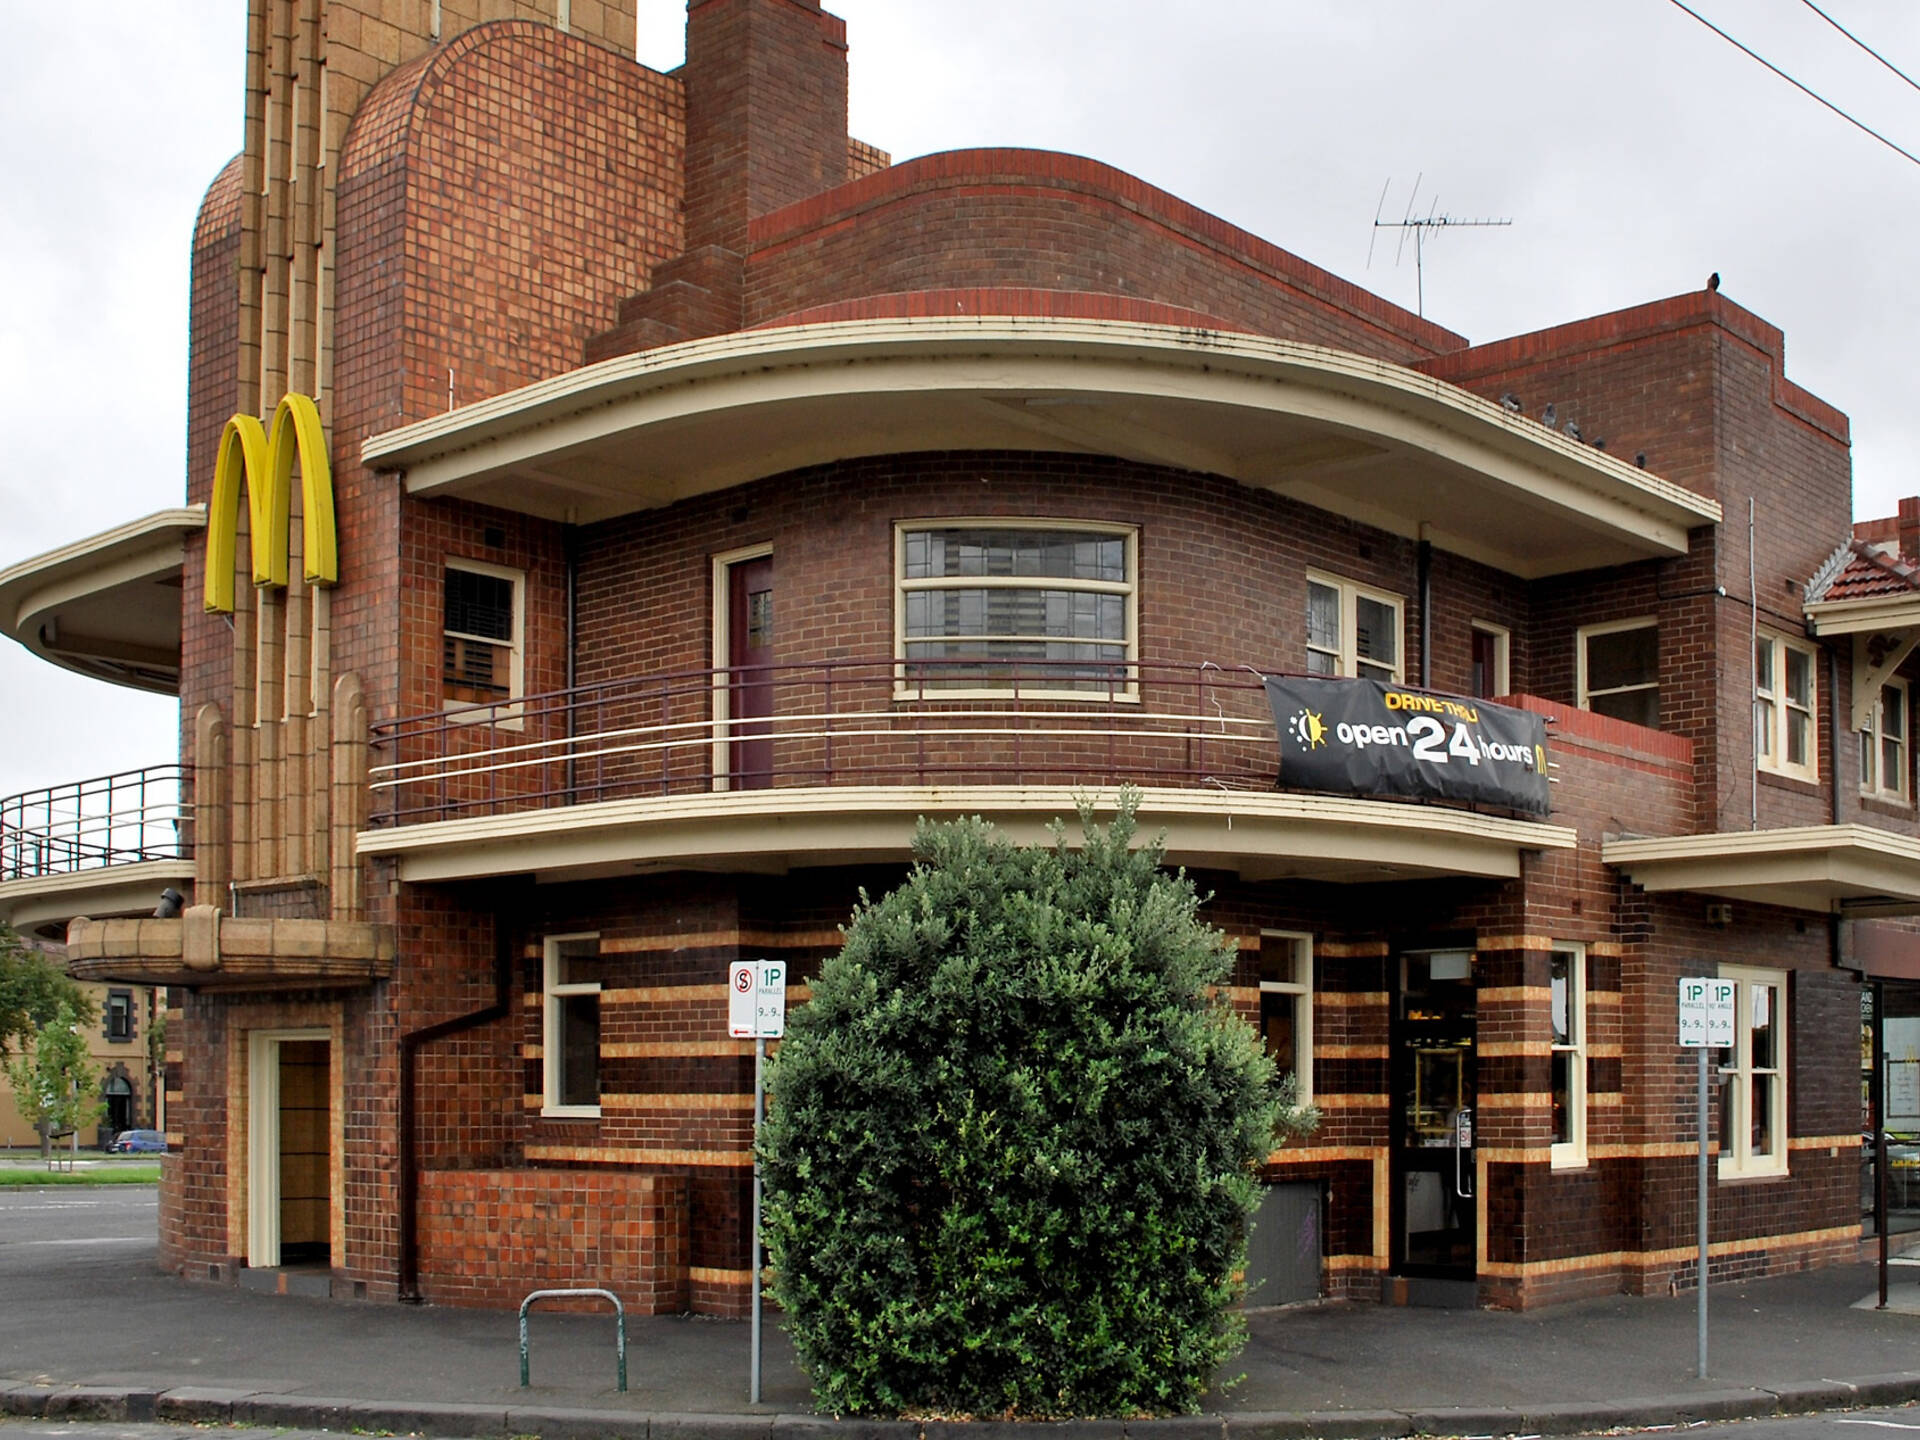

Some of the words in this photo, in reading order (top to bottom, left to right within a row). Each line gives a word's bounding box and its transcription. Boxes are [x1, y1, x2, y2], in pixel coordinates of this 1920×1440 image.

[1336, 721, 1408, 749] open
[1406, 715, 1481, 766] 24
[1476, 735, 1534, 765] hours
[764, 969, 781, 986] 1P
[1687, 985, 1703, 1001] 1P
[1715, 986, 1731, 1002] 1P
